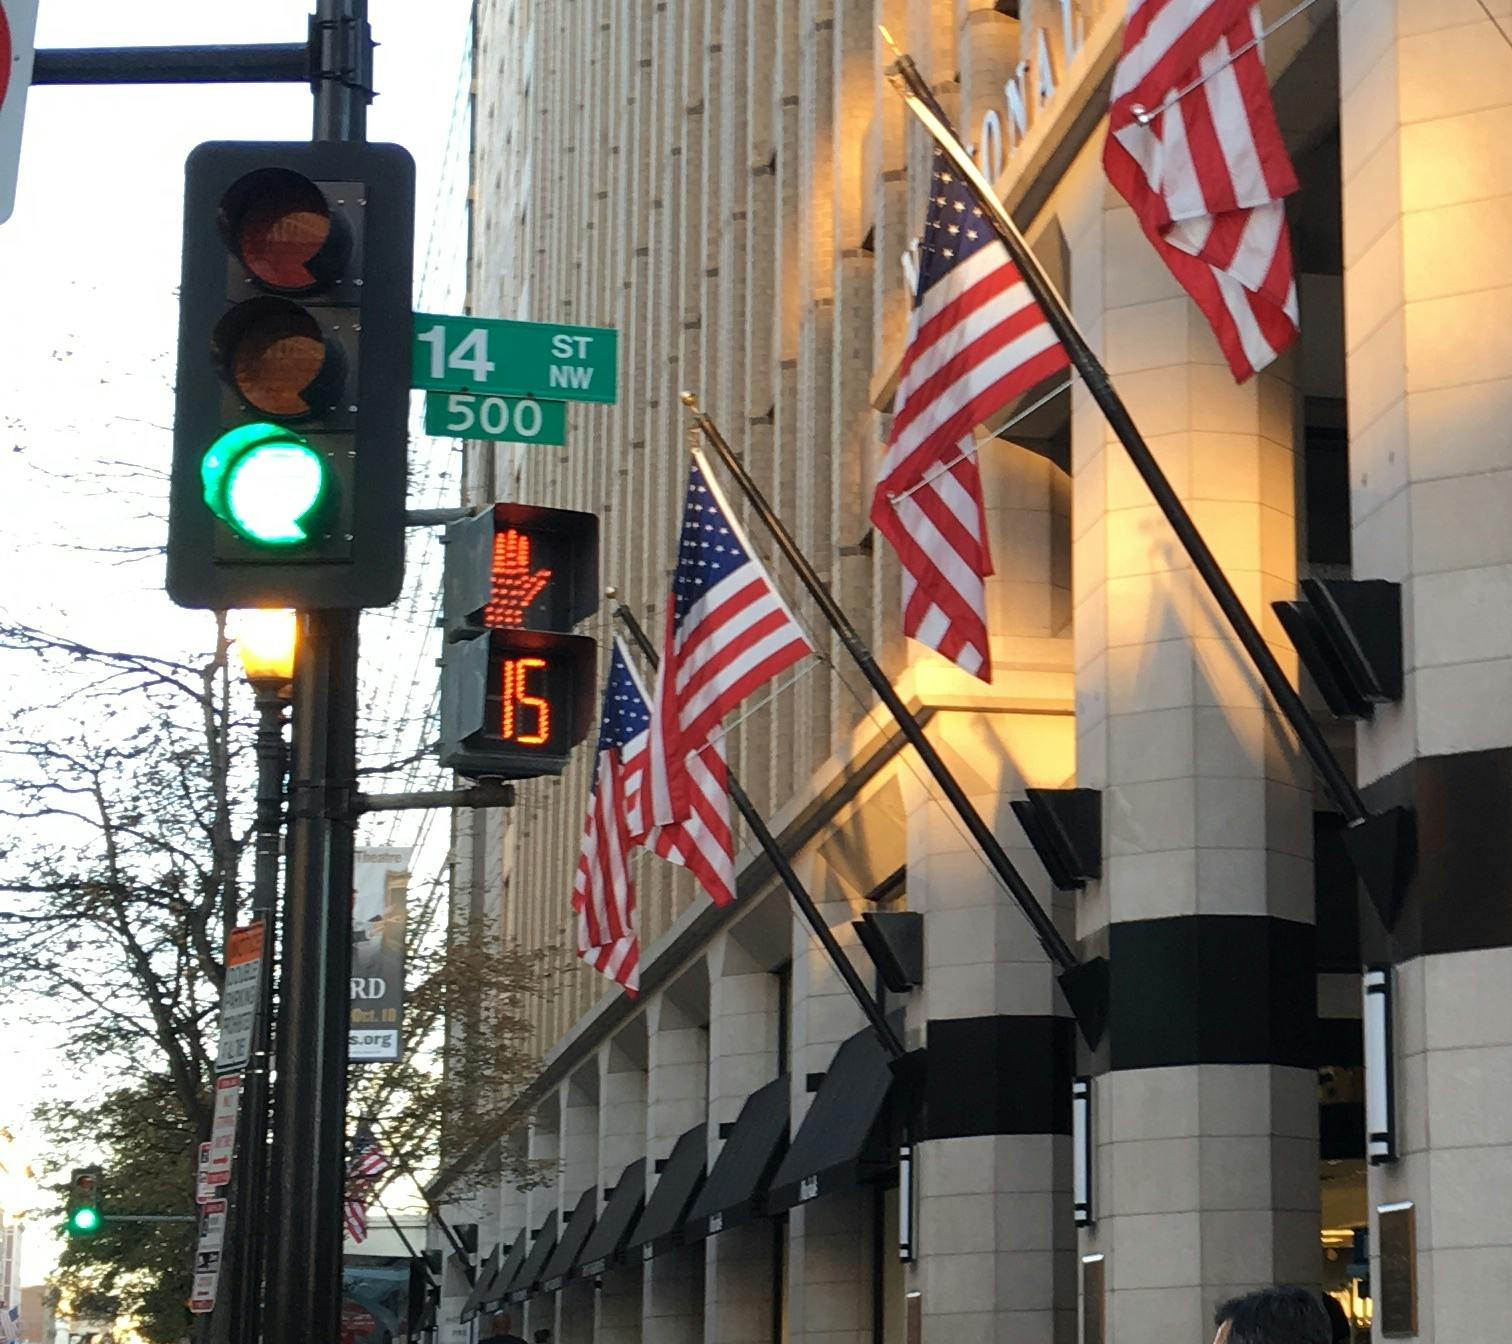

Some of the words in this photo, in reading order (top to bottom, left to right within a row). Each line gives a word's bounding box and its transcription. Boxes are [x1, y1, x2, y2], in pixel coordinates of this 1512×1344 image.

[417, 324, 496, 383] 14
[551, 334, 594, 360] ST
[549, 365, 594, 390] NW
[446, 394, 544, 437] 500
[500, 657, 551, 746] 15
